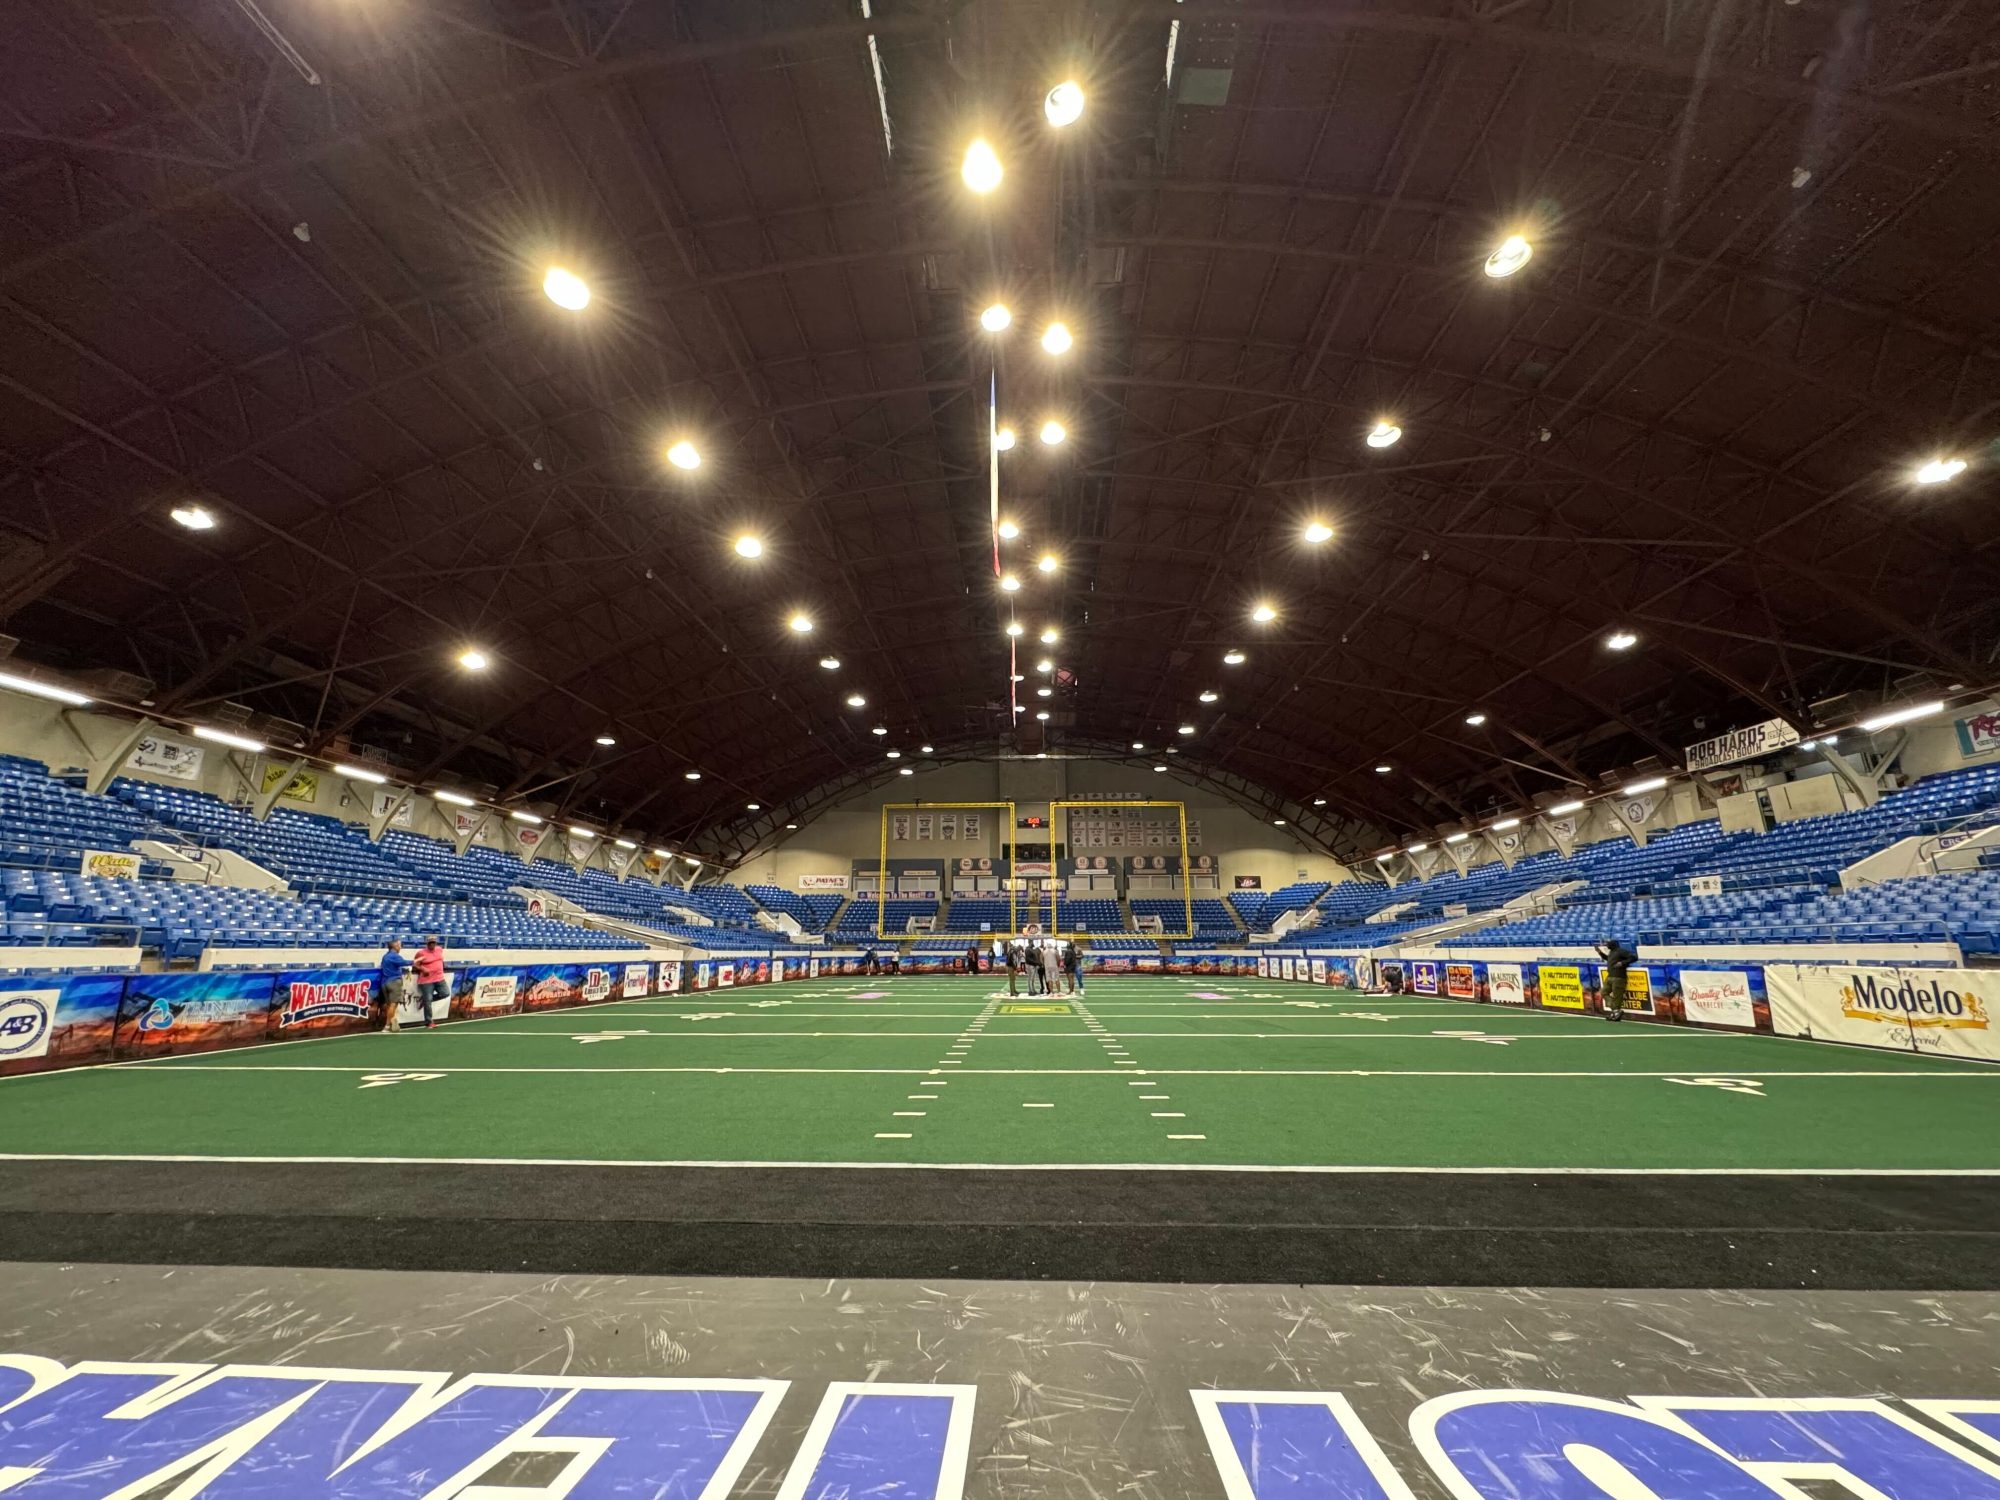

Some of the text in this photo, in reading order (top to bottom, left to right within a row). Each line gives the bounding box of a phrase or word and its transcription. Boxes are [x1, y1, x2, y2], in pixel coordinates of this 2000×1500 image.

[1690, 740, 1716, 763] BOB
[1736, 742, 1762, 758] BOOTH
[664, 962, 678, 970] AFL
[1550, 994, 1581, 1002] NUTRITION
[1628, 992, 1648, 1000] LUBE
[1852, 975, 1963, 1016] Modelo
[303, 1007, 326, 1017] SPORTS
[1889, 1028, 1943, 1047] Especial
